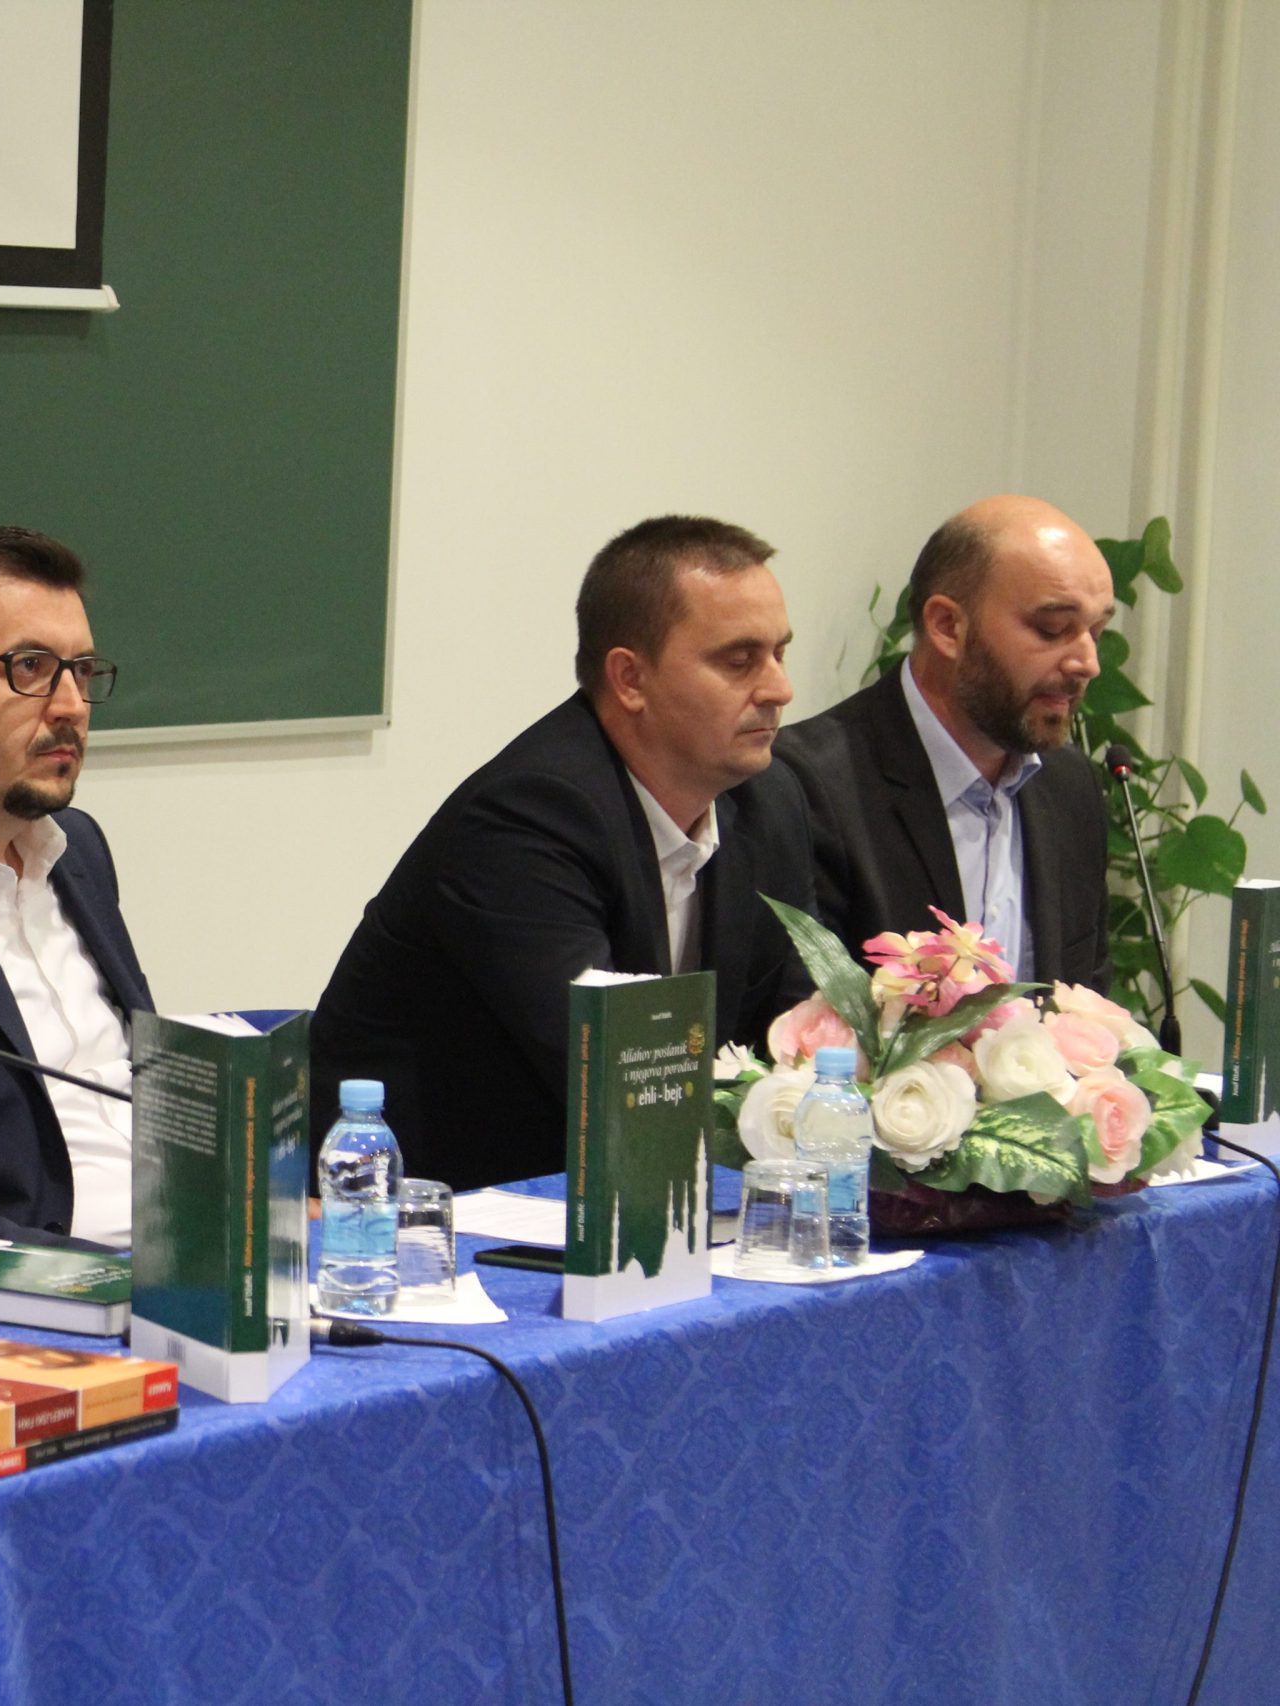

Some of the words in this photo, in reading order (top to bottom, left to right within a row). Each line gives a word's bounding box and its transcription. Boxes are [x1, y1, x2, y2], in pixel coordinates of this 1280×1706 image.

[618, 1047, 652, 1064] Allahov
[652, 1040, 688, 1064] poslanik
[630, 1066, 662, 1086] njegova
[662, 1058, 699, 1081] porodica
[638, 1085, 657, 1106] ehli
[664, 1083, 683, 1107] bejt
